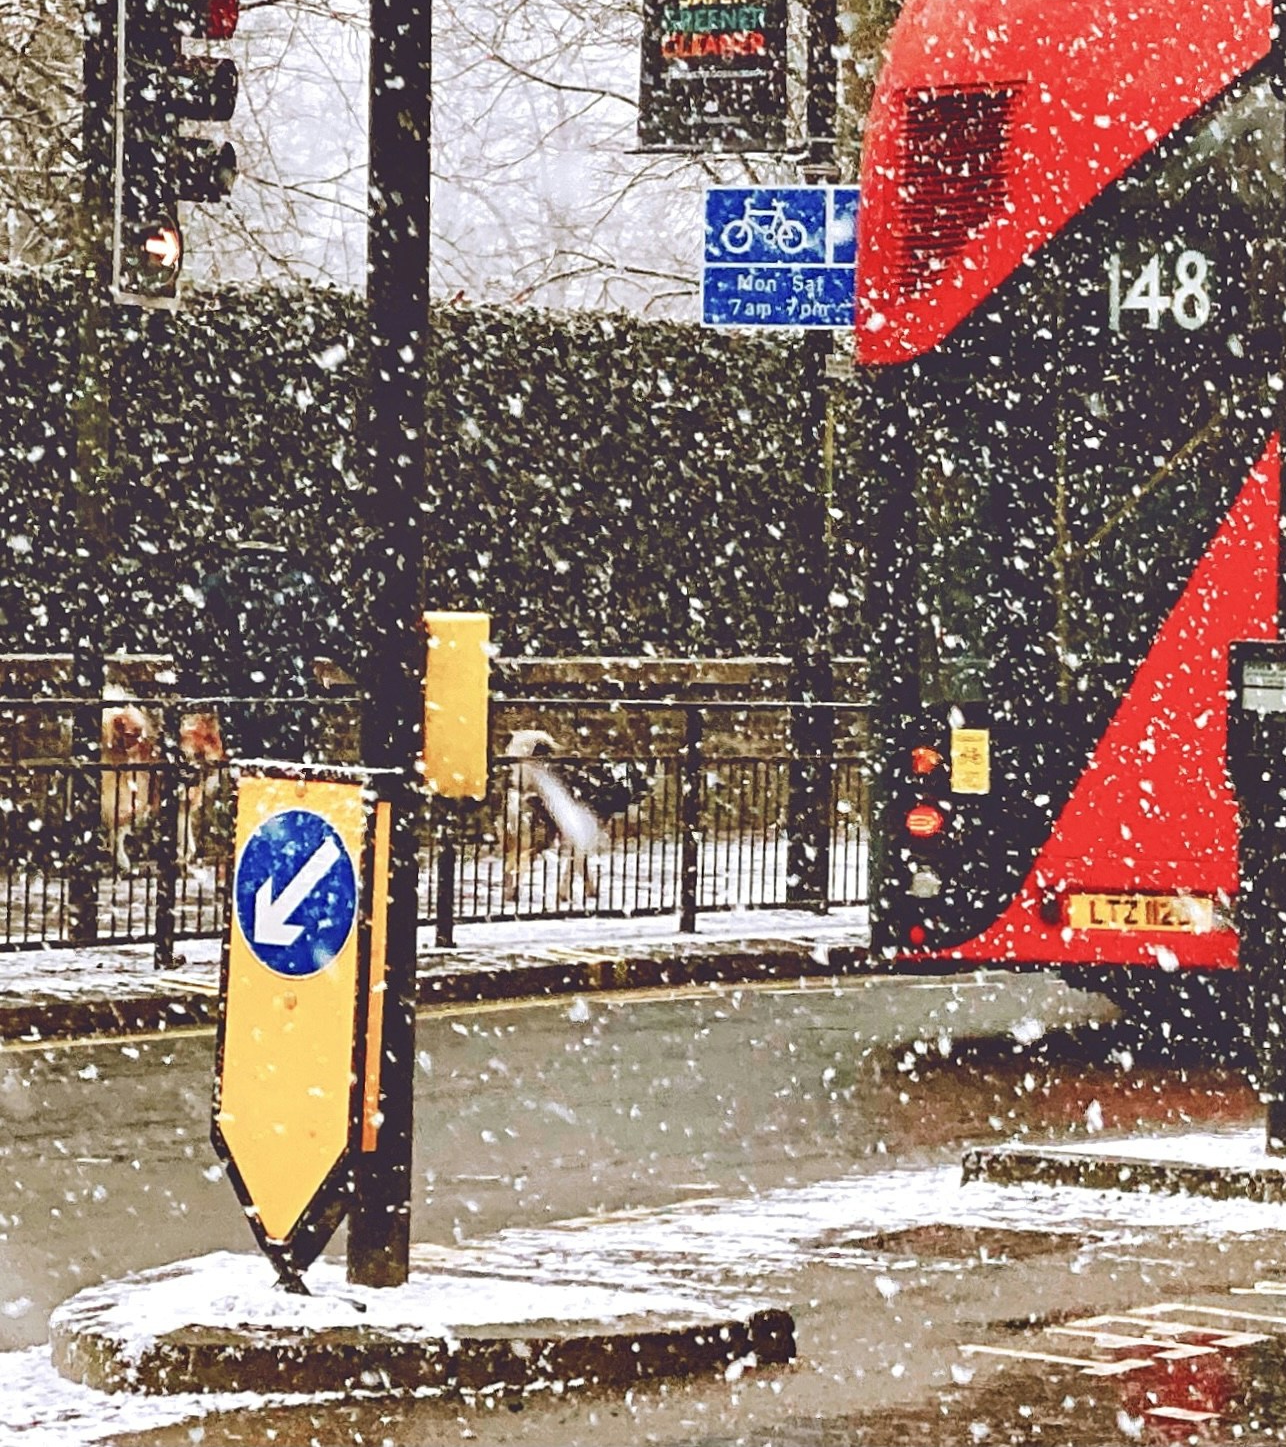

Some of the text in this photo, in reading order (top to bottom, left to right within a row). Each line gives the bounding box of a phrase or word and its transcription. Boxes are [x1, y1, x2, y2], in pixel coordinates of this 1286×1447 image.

[737, 274, 777, 292] Mon
[792, 275, 825, 293] Sat
[1108, 249, 1211, 332] 148
[1089, 899, 1138, 925] LTZ
